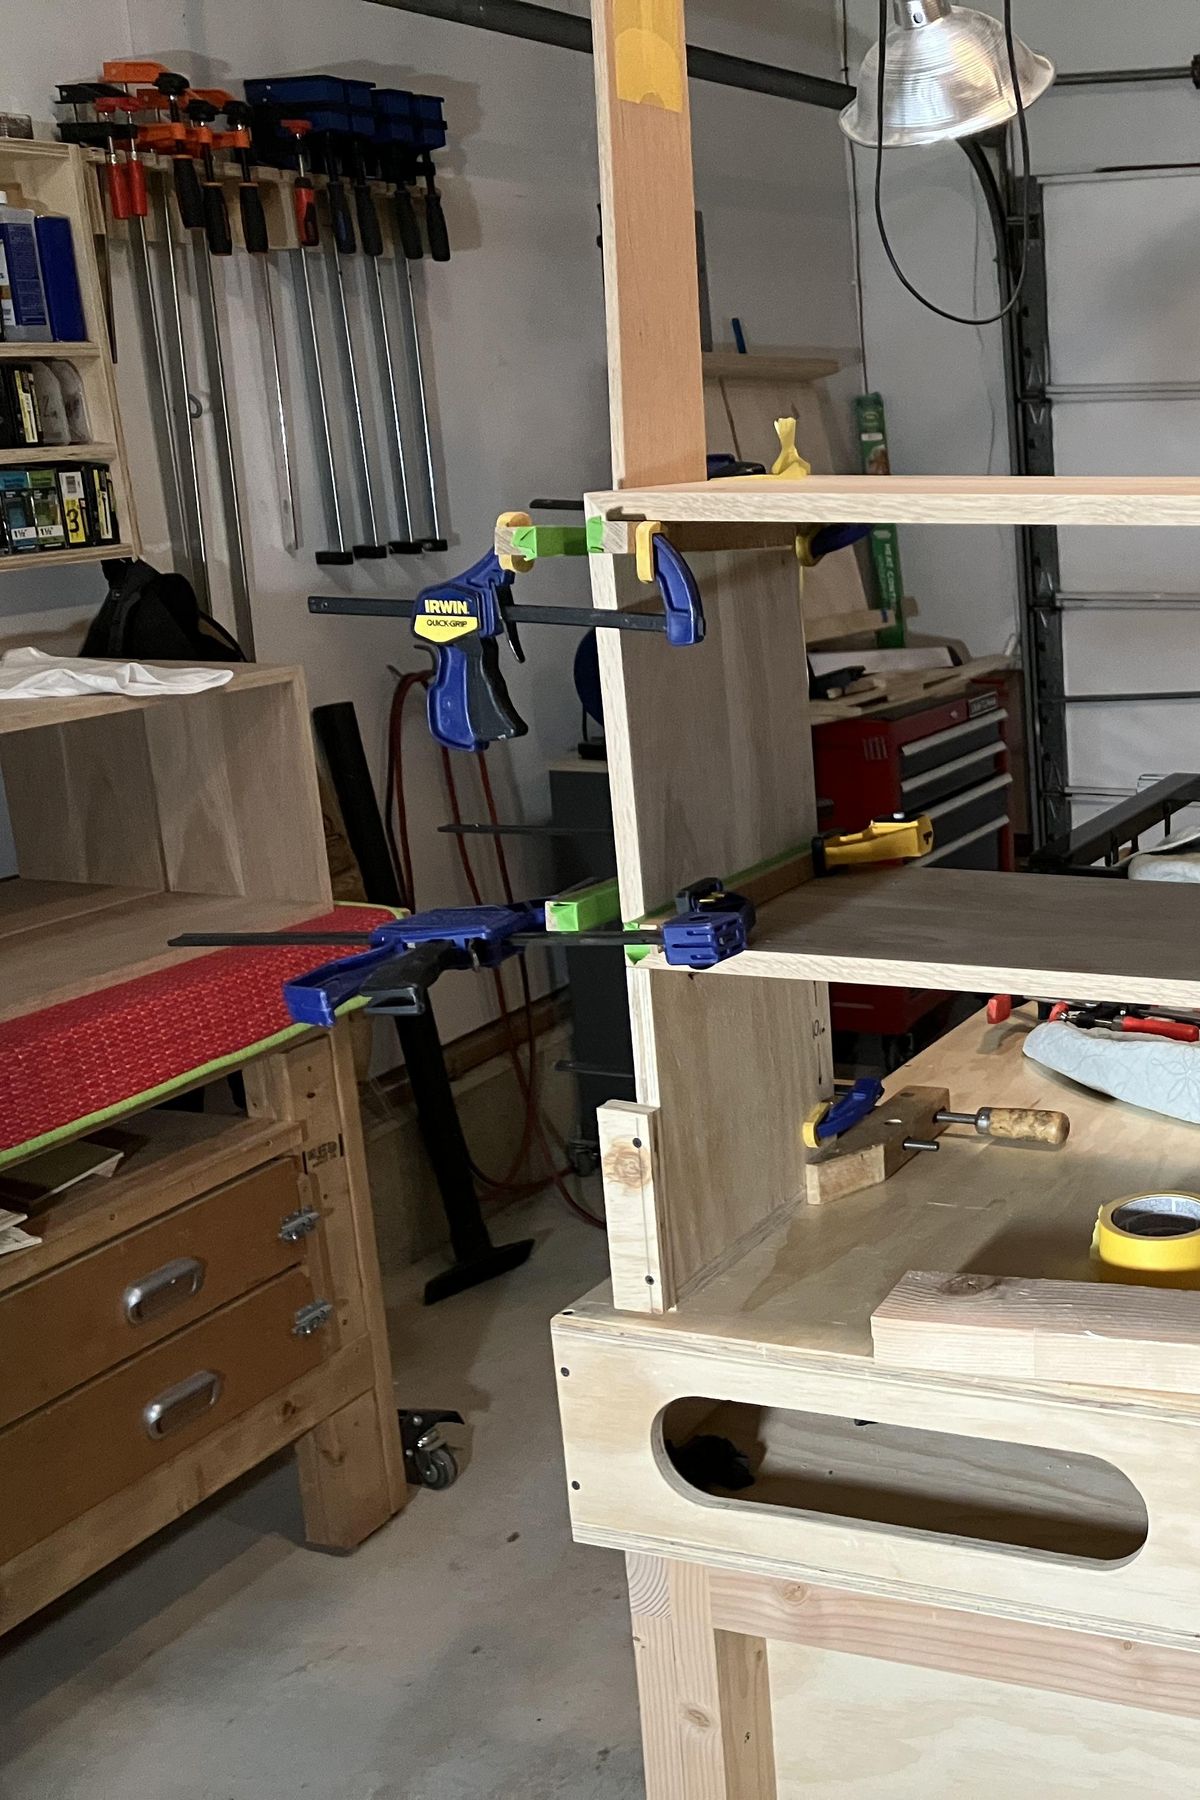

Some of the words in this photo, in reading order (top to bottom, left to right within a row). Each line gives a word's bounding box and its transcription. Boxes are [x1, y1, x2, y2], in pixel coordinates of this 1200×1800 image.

[66, 508, 79, 533] 3
[424, 599, 468, 614] IRWIN
[426, 619, 467, 628] QUICK-GRIP
